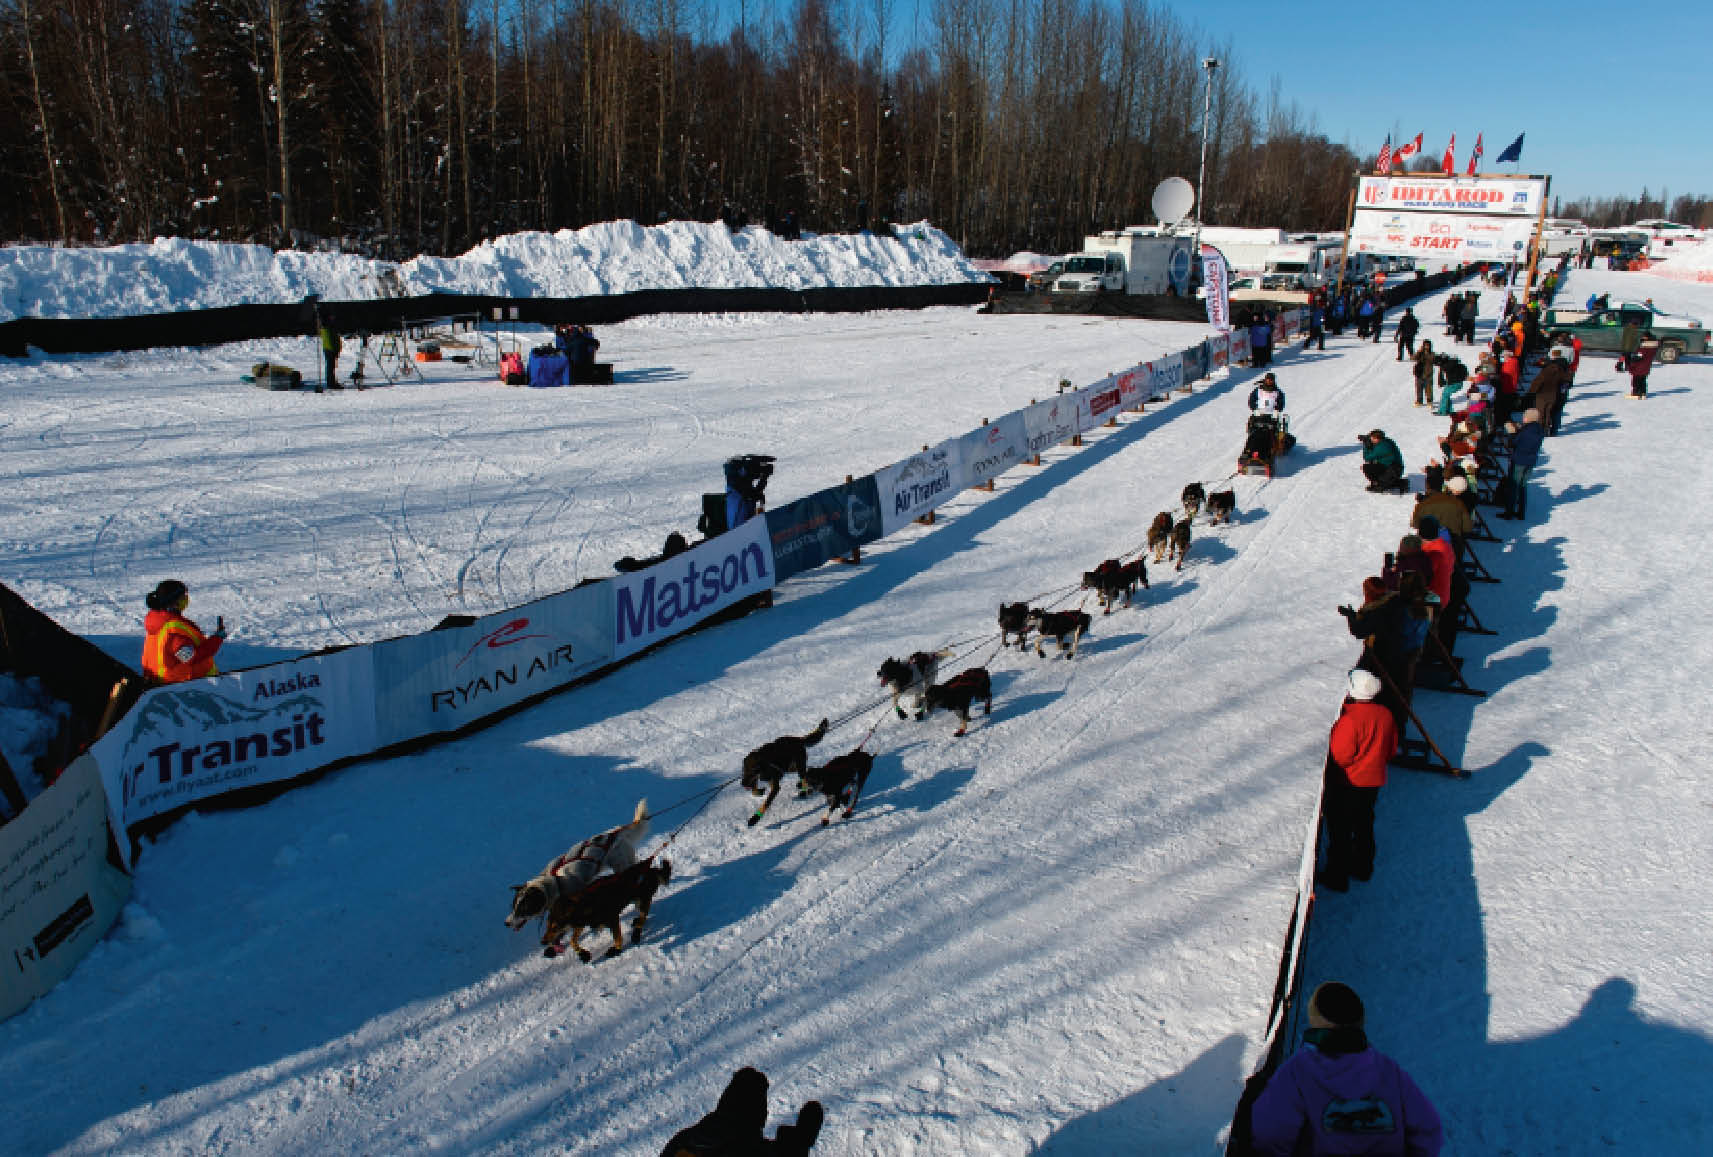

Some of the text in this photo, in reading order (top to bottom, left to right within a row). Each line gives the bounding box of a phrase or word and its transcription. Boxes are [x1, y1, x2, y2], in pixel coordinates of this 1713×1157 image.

[1409, 235, 1464, 249] START
[616, 542, 770, 644] Matson
[254, 671, 321, 703] Alaska
[431, 663, 518, 713] RYAN
[527, 643, 574, 681] AIR
[148, 711, 326, 785] Transit
